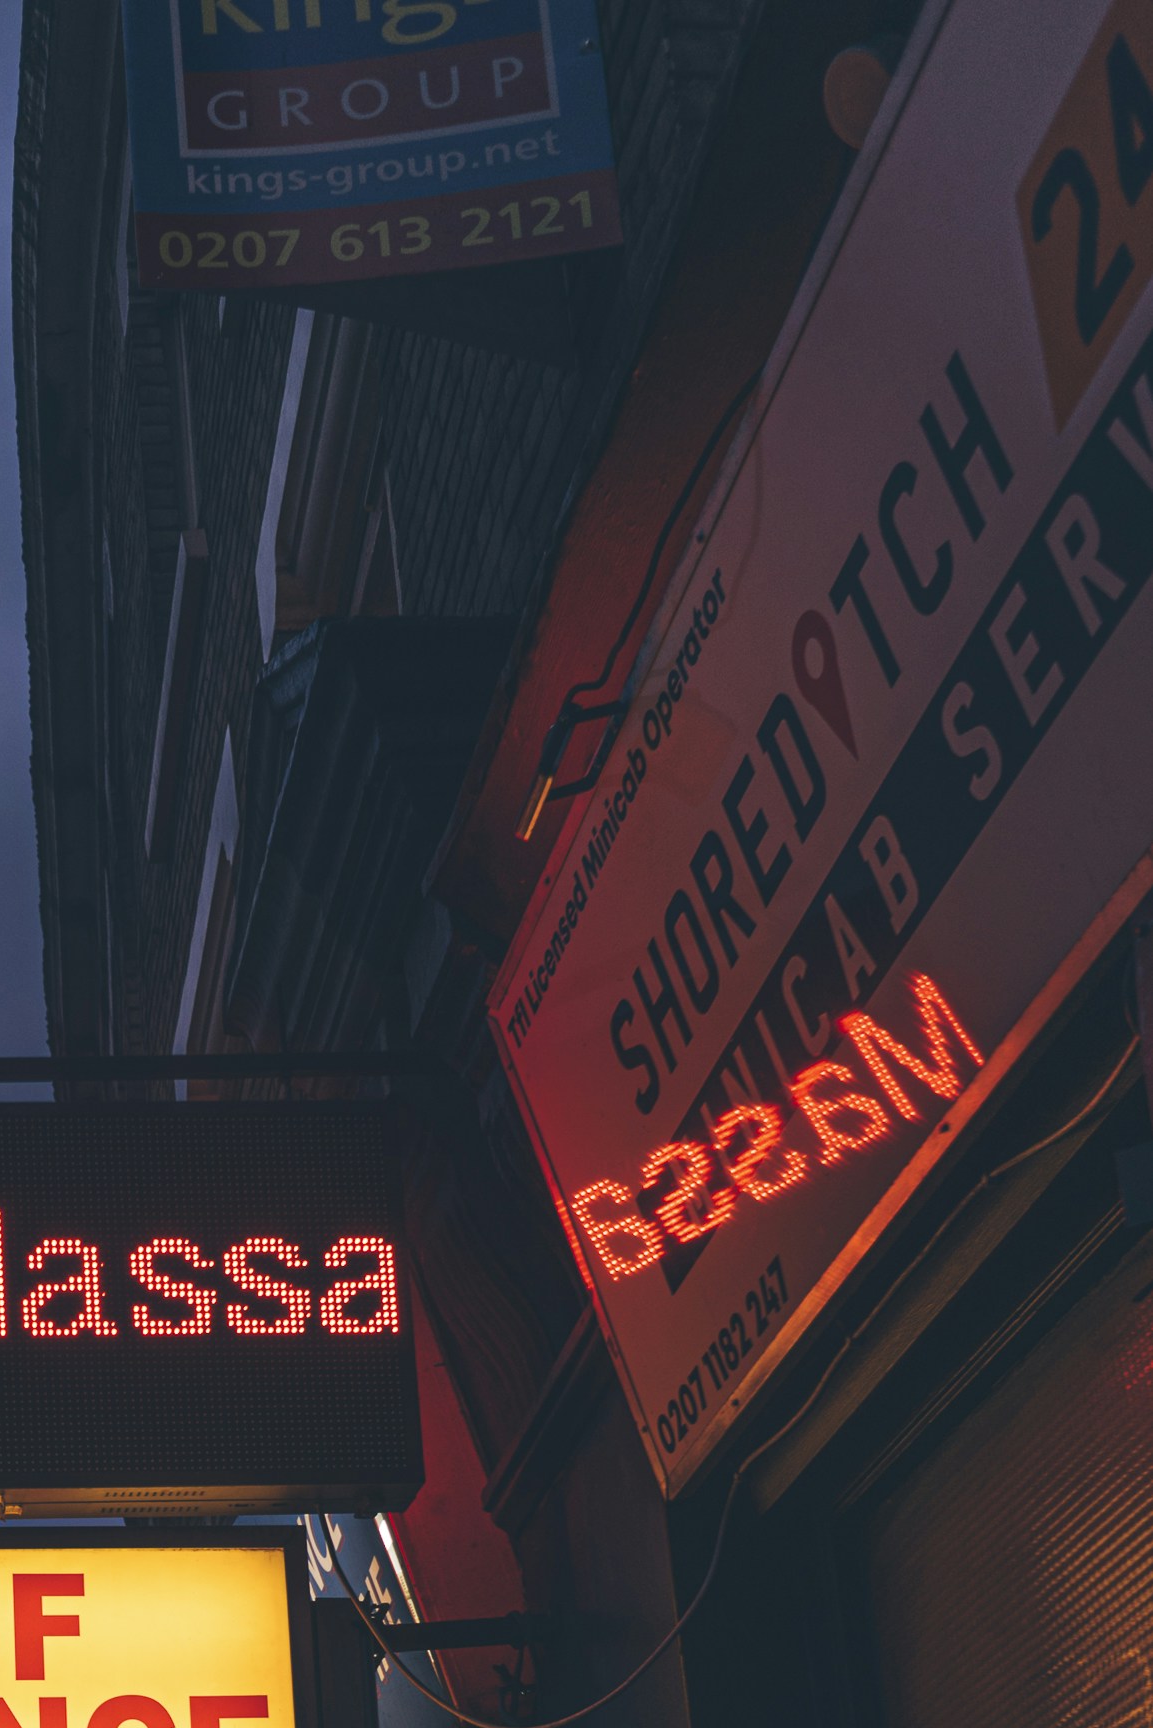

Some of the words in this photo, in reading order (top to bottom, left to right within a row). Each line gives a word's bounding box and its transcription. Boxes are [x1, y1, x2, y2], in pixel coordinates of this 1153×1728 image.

[207, 57, 524, 131] GROUP
[187, 127, 562, 200] kings-group.net
[159, 228, 301, 269] 0207
[330, 216, 432, 262] 613
[460, 190, 594, 247] 2121
[524, 879, 587, 1015] Licensed
[582, 748, 649, 892] Minicab
[643, 567, 728, 753] Operator
[657, 1365, 707, 1454] 0207
[701, 1312, 753, 1391] 1182
[746, 1254, 789, 1337] 247
